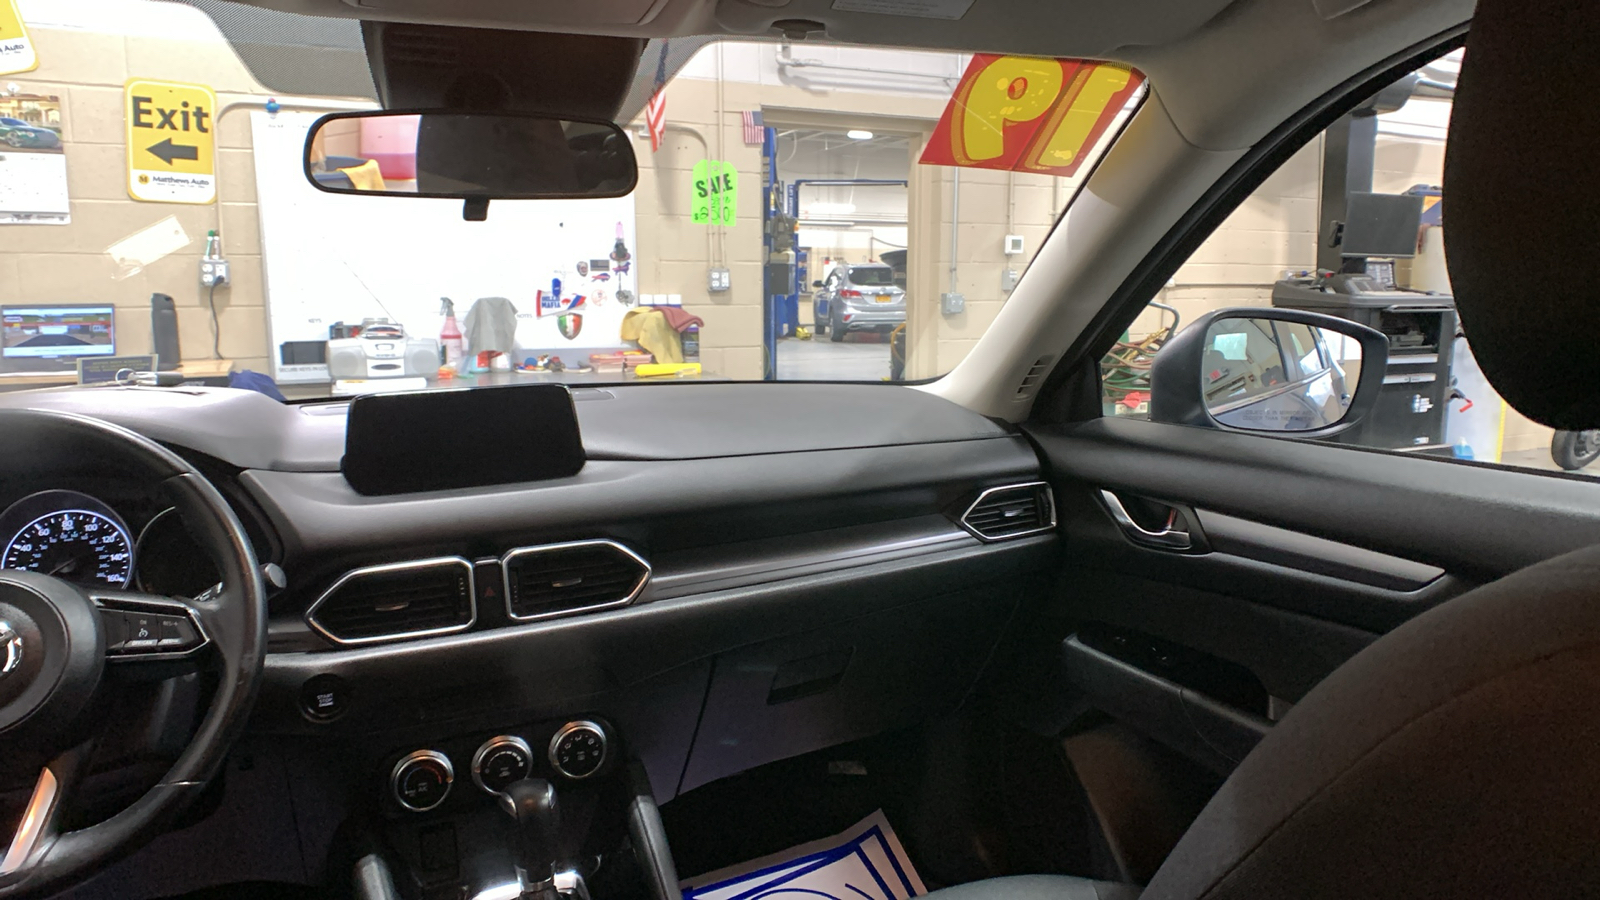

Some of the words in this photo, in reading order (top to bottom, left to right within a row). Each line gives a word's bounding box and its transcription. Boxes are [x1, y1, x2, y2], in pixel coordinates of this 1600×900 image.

[132, 95, 209, 133] Exit
[152, 176, 190, 184] Matthews
[191, 178, 210, 186] Auto
[695, 173, 733, 198] SALE
[541, 300, 561, 308] MAFIA
[38, 528, 50, 536] 60
[102, 535, 115, 543] 120
[110, 553, 123, 561] 140
[107, 574, 120, 582] 160
